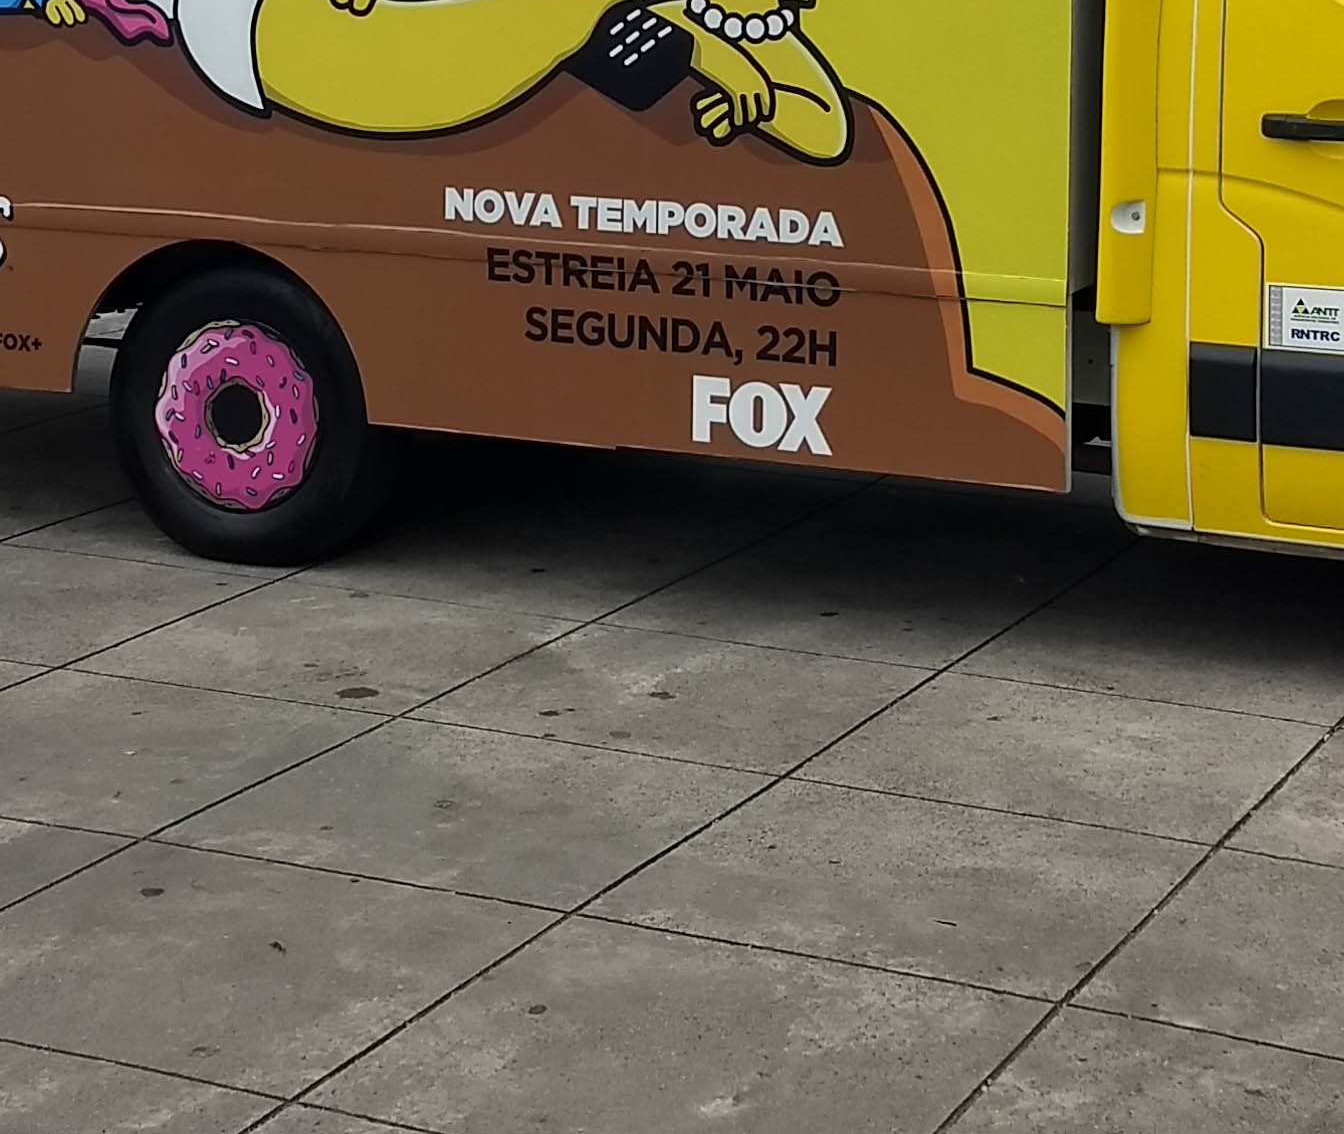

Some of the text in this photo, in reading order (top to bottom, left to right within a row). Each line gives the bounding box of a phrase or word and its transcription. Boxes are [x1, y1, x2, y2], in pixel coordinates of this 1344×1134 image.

[444, 186, 844, 248] NOVA TEMPORADA
[486, 247, 842, 308] ESTREIA 21 MAIO
[524, 306, 838, 367] SEGUNDA, 22H
[1290, 328, 1340, 342] RNTRC
[1310, 306, 1340, 316] ANTT
[691, 374, 833, 456] FOX
